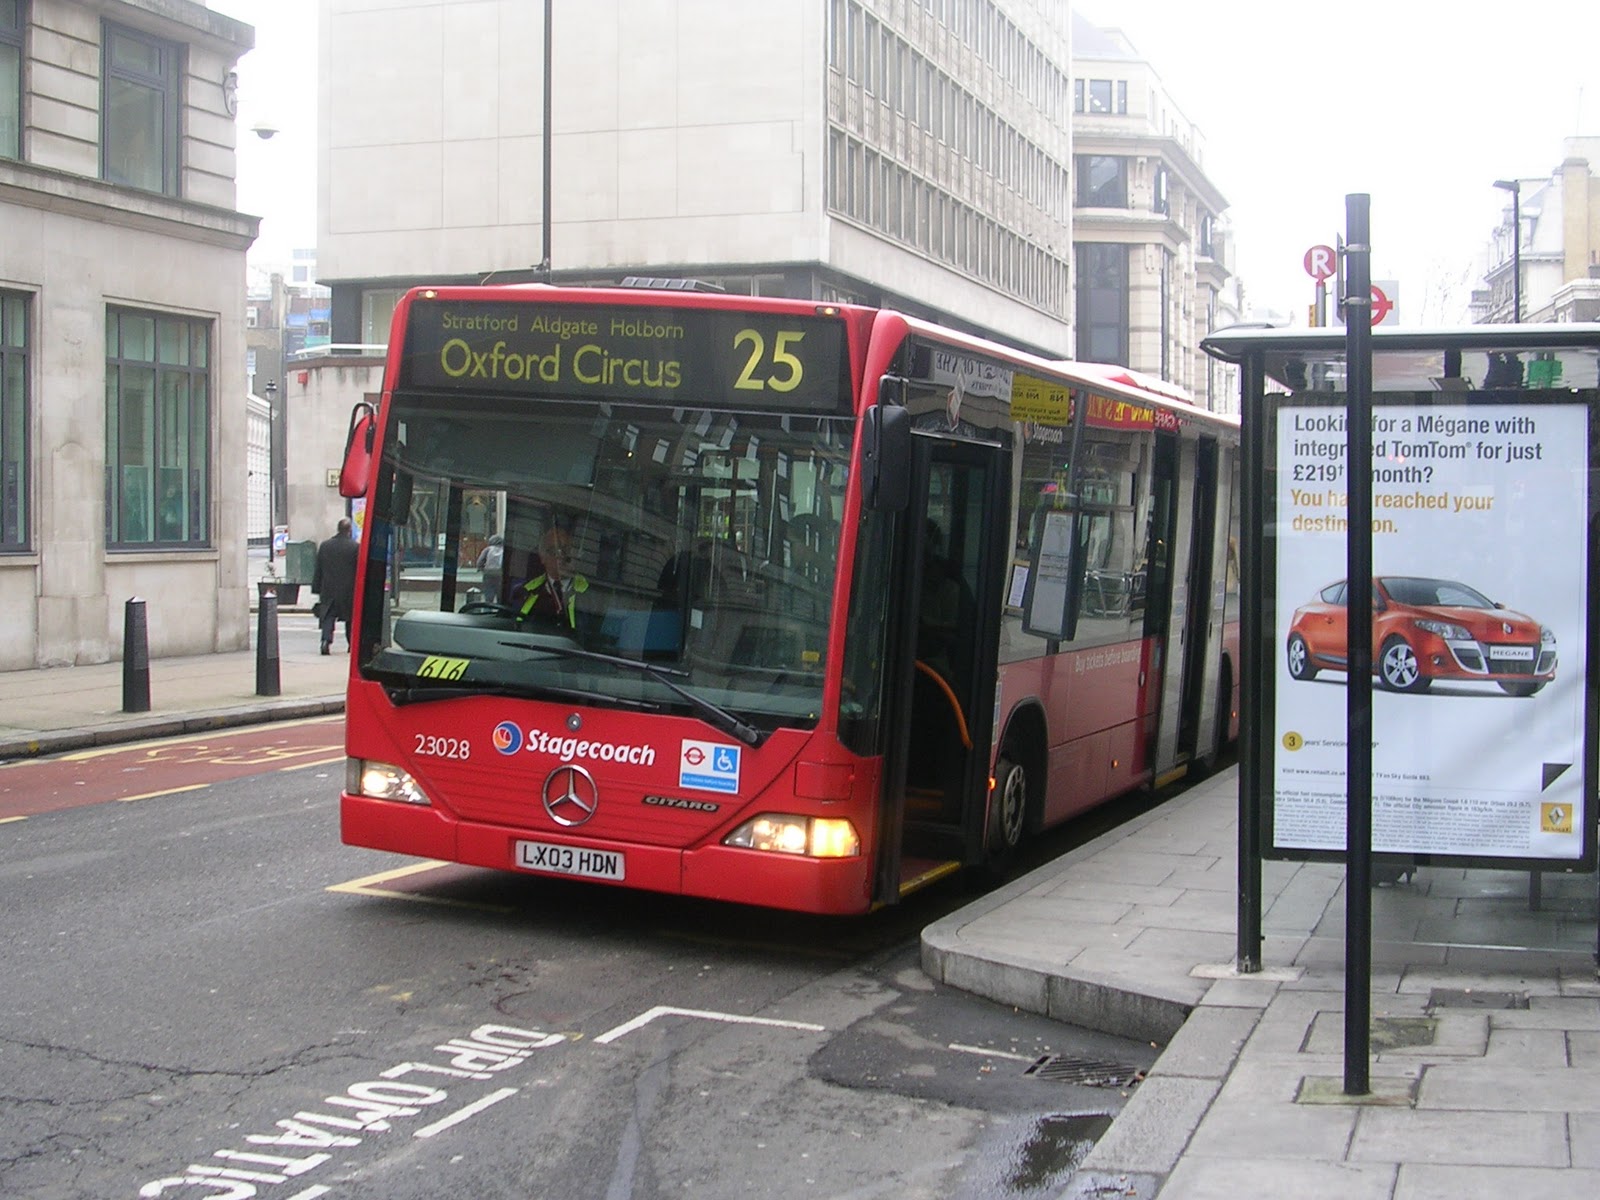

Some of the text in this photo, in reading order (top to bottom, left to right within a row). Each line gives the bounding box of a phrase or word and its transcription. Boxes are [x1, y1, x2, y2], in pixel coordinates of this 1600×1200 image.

[1311, 249, 1330, 277] R
[442, 311, 684, 340] Stratford Aldgate Holborn
[441, 338, 681, 389] Oxford Circus
[733, 329, 806, 393] 25
[1294, 414, 1535, 437] Looki for a Mégane with
[1476, 441, 1502, 460] for
[1506, 441, 1542, 463] just
[1291, 489, 1323, 507] You
[1375, 491, 1448, 509] reached
[1453, 495, 1494, 513] your
[1292, 514, 1398, 533] destinon.
[414, 734, 470, 760] 23028
[526, 728, 656, 767] Stagecoach
[1288, 735, 1296, 747] 3
[645, 795, 717, 812] CITARO
[522, 844, 617, 875] LX03 HDN
